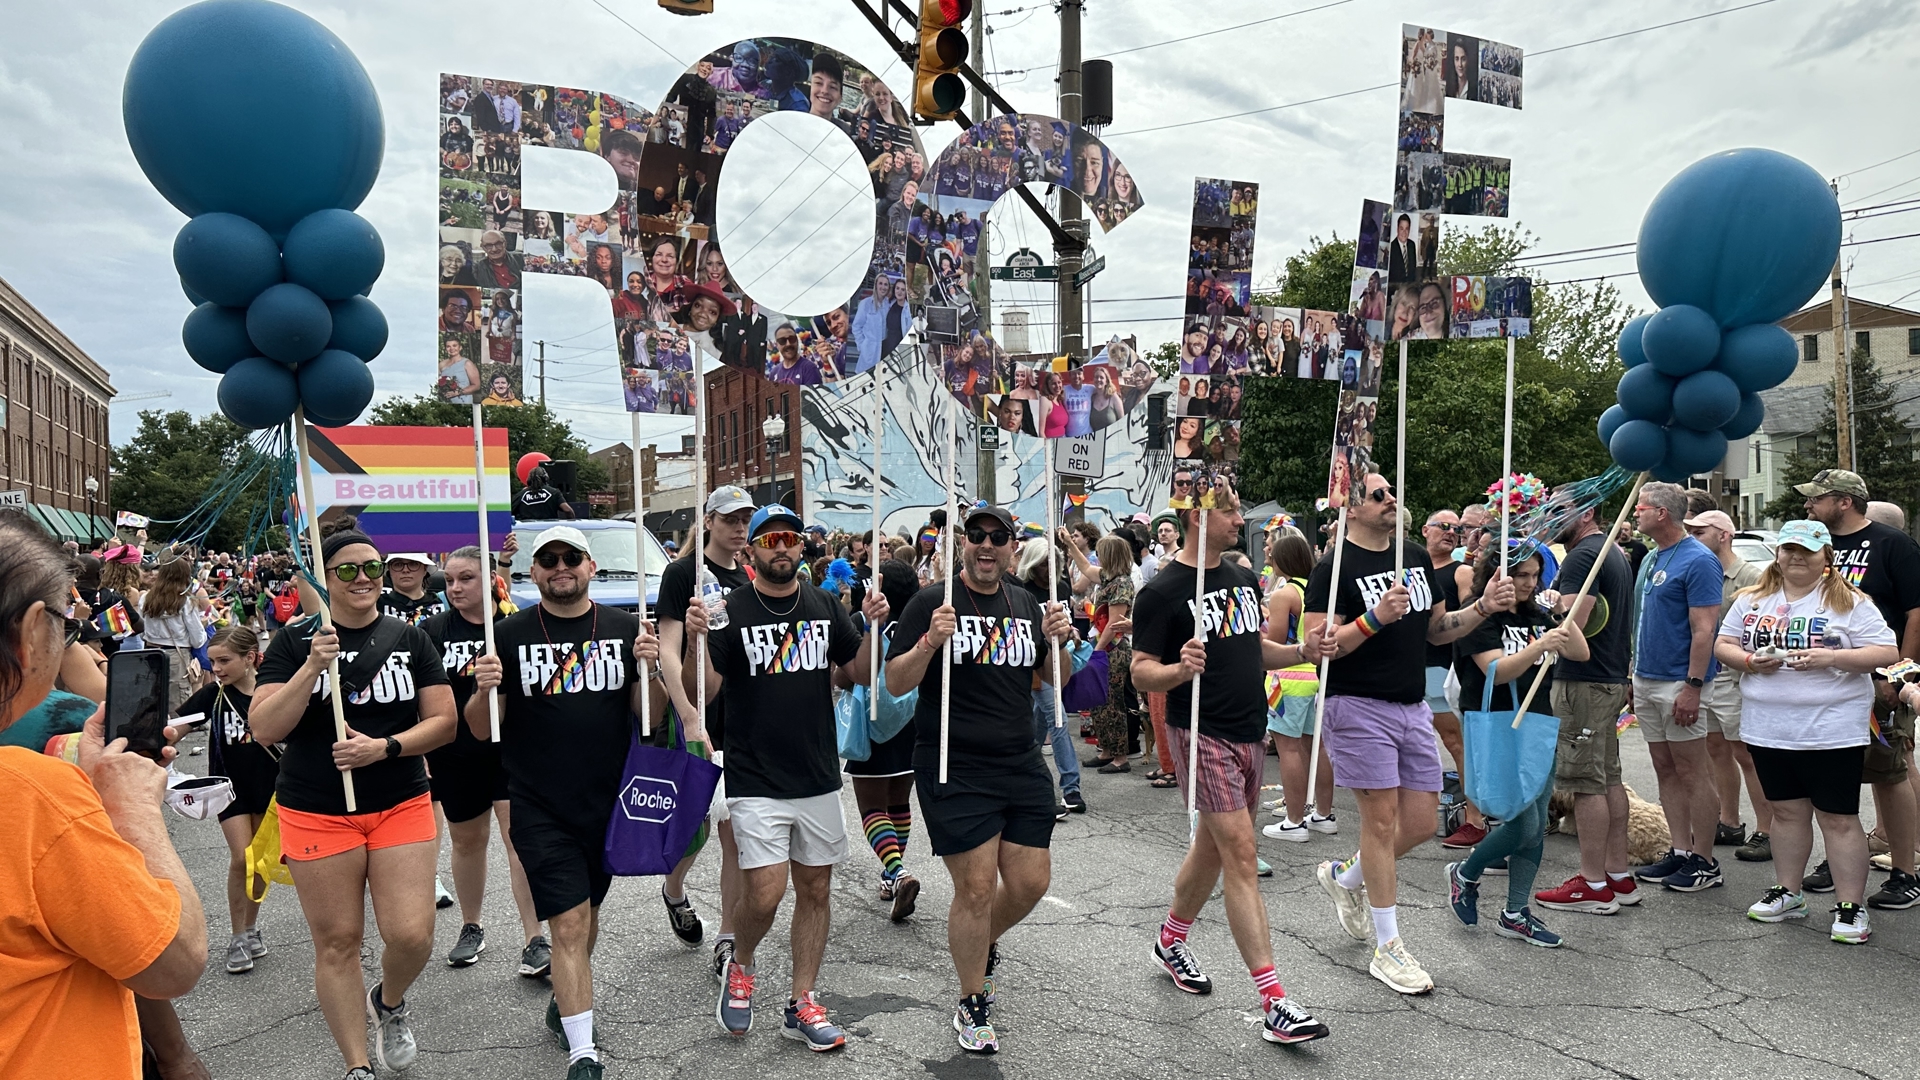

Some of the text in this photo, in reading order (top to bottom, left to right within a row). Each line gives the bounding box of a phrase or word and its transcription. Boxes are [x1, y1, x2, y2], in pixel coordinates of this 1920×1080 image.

[1013, 267, 1036, 279] East
[1072, 443, 1089, 456] ON
[1068, 457, 1090, 471] RED
[0, 494, 22, 505] NE
[335, 479, 476, 499] Beautiful
[1844, 549, 1870, 567] ALL
[1233, 586, 1258, 607] GET
[740, 619, 831, 648] LET'S GET
[1003, 616, 1032, 640] GET
[1743, 613, 1829, 634] PRIDE
[518, 638, 624, 667] LET'S GET
[744, 640, 830, 676] PROUD
[952, 631, 1036, 667] PROUD
[519, 659, 625, 697] PROUD
[630, 786, 673, 810] Roche
